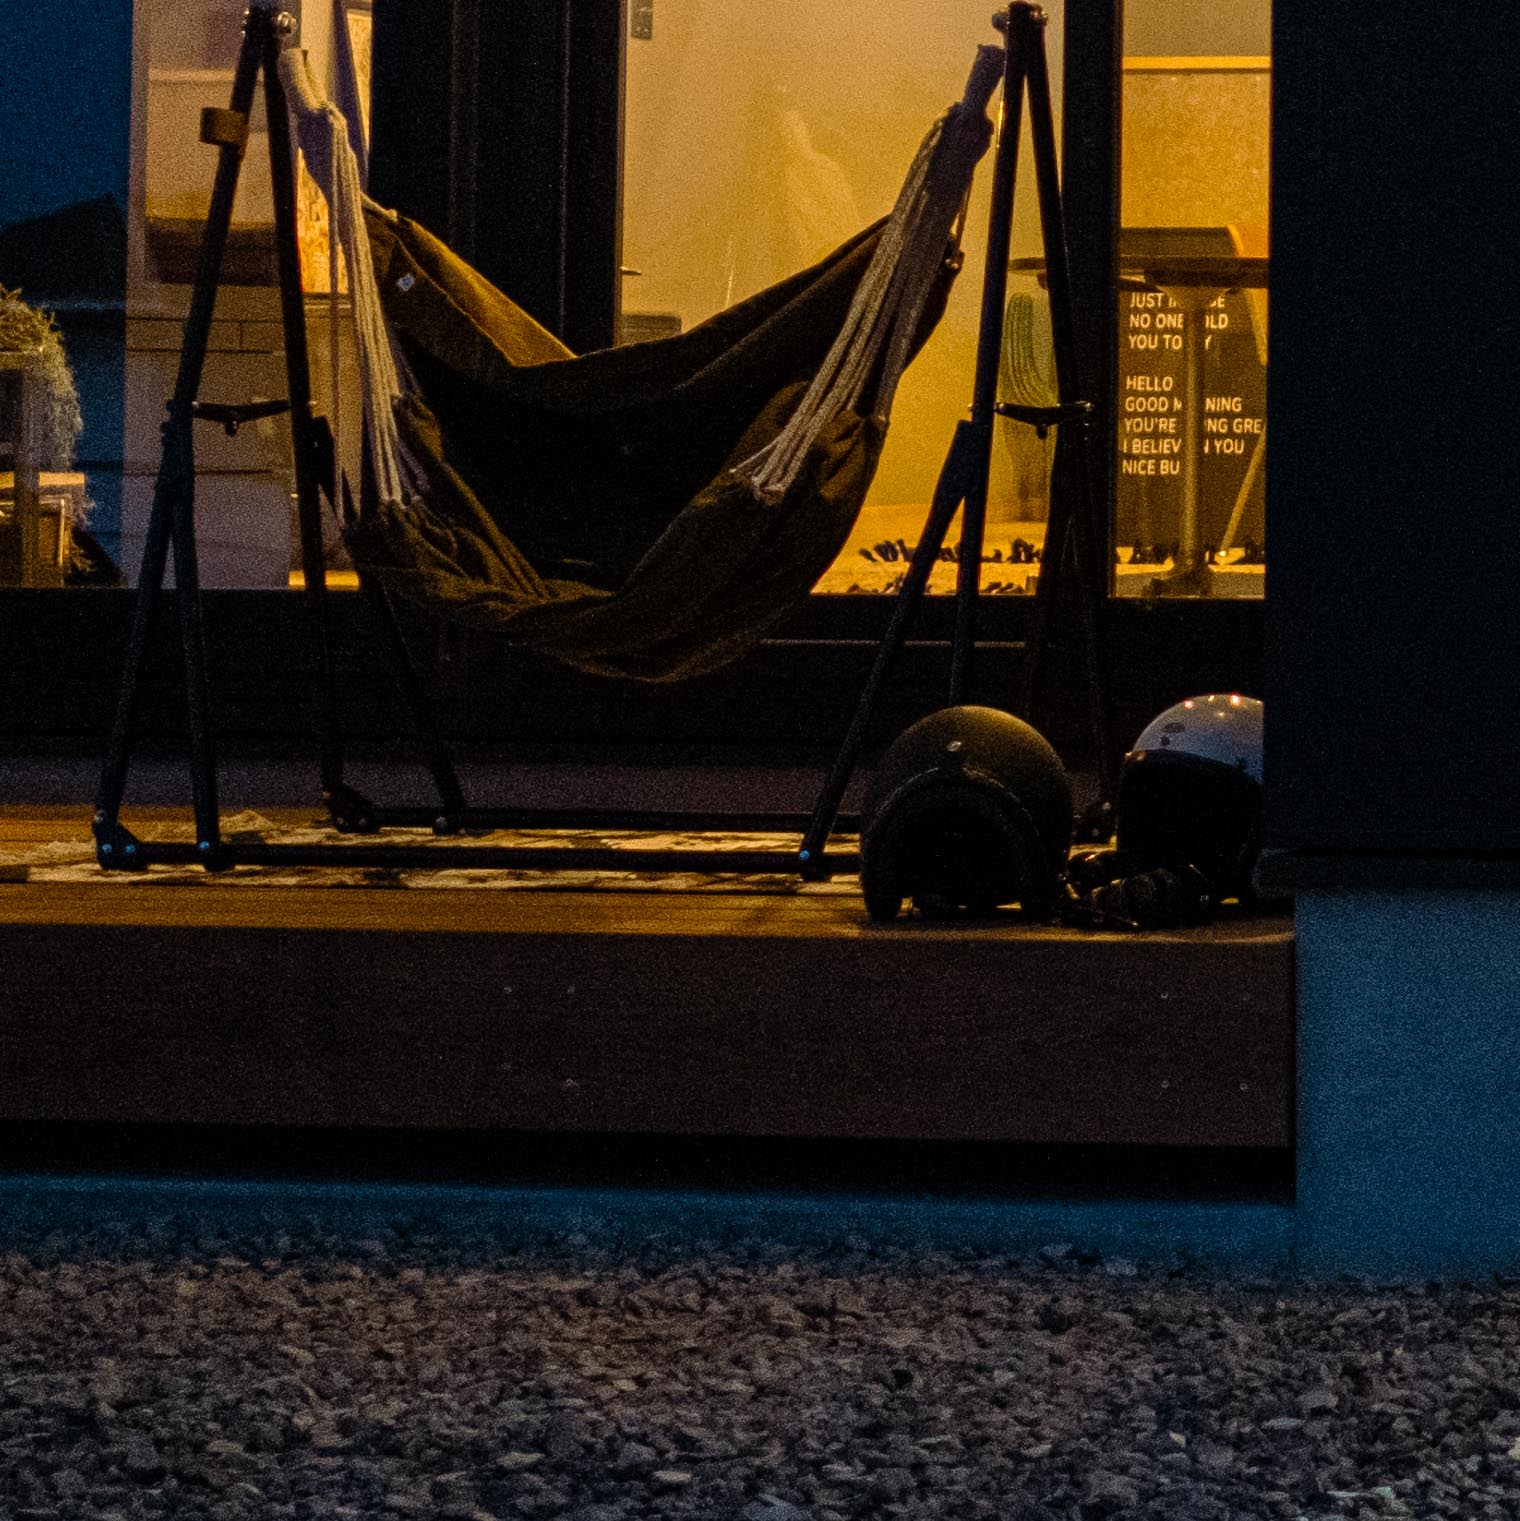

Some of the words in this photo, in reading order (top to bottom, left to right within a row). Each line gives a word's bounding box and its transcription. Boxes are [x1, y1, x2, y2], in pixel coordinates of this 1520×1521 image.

[1130, 292, 1164, 308] JUST
[1129, 314, 1150, 328] NO
[1156, 314, 1184, 328] ONE
[1129, 334, 1158, 349] YOU
[1126, 376, 1173, 391] HELLO
[1125, 397, 1168, 412] GOOD
[1173, 397, 1242, 412] MNING
[1124, 418, 1177, 433] YOU'RE
[1233, 418, 1265, 433] GRE
[1123, 439, 1128, 454] I
[1132, 439, 1182, 454] BELIEV
[1214, 439, 1245, 454] YOU
[1122, 459, 1157, 475] NICE
